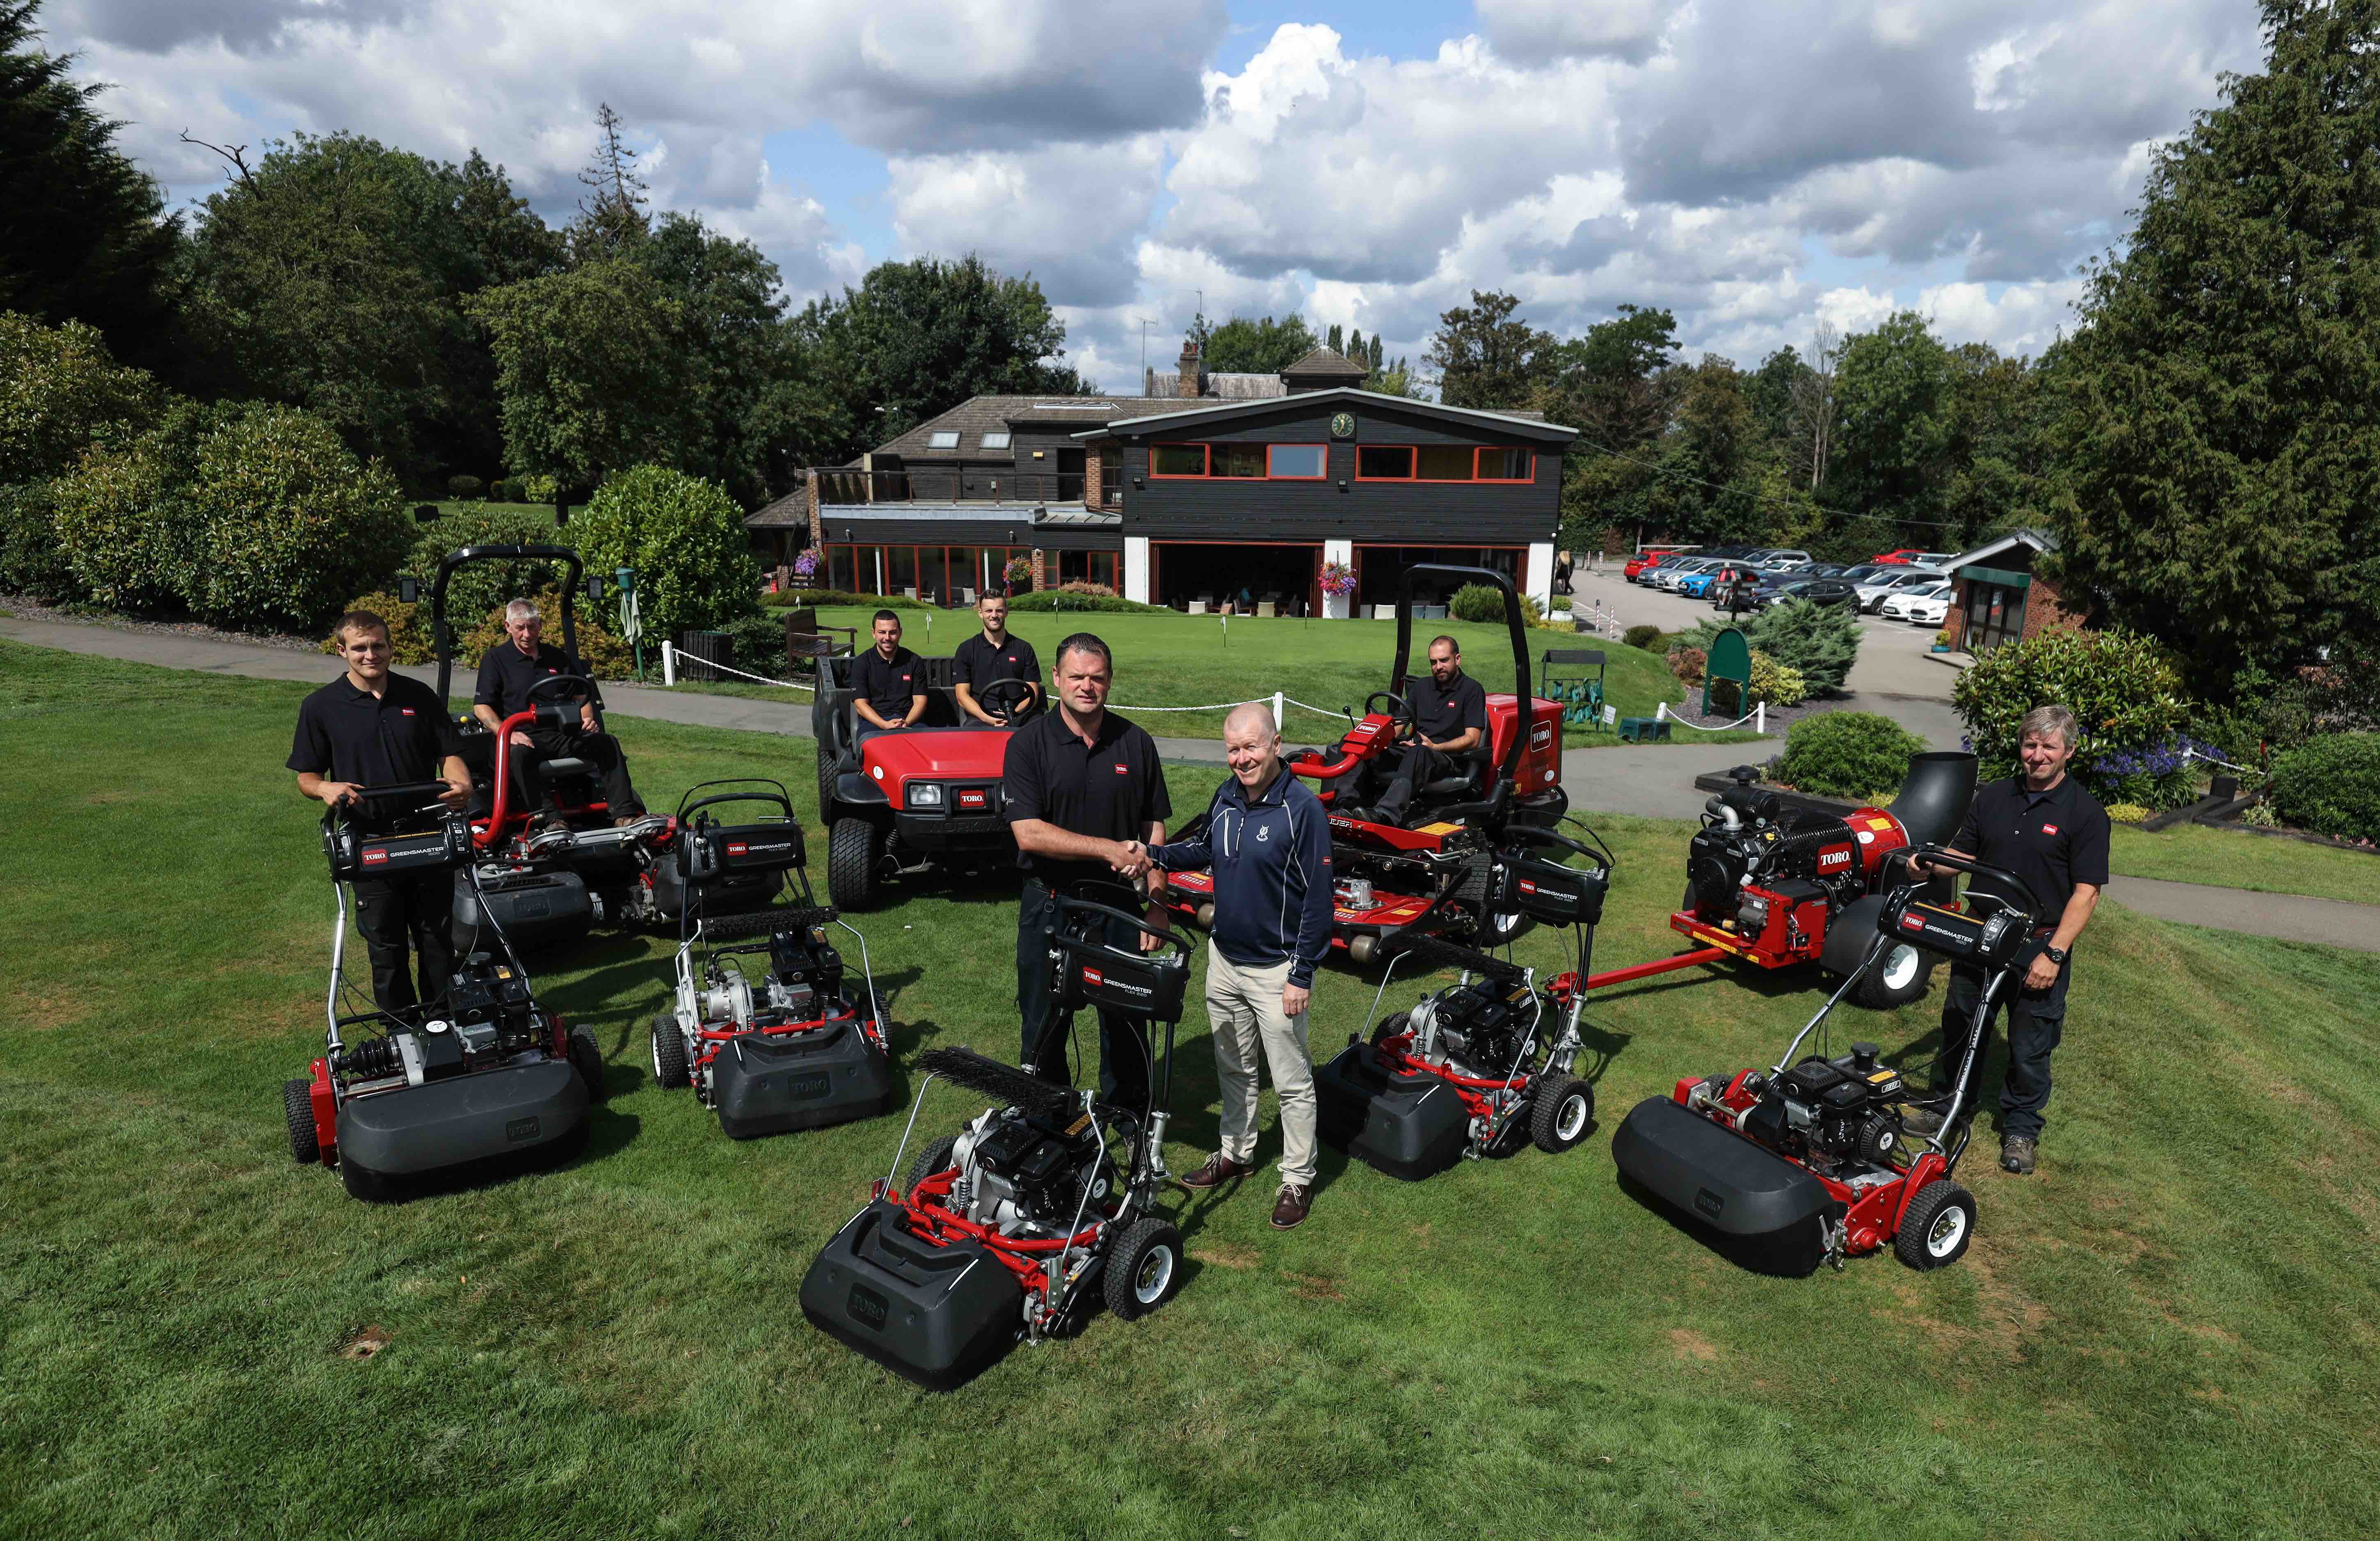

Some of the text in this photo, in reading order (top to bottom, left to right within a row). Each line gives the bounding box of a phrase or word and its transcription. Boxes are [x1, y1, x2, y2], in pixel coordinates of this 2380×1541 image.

[1533, 729, 1549, 743] TORO
[929, 821, 1008, 834] WORKMA
[390, 846, 444, 857] GREENSMASTER
[1821, 851, 1850, 866] TORO
[1520, 882, 1578, 900] TORO GREENSMASTER
[1905, 916, 1973, 943] TORO GREENSMASTER
[1084, 971, 1152, 994] TORO GREENSMASTER
[791, 1080, 826, 1093] TORO
[854, 1294, 885, 1321] TORO
